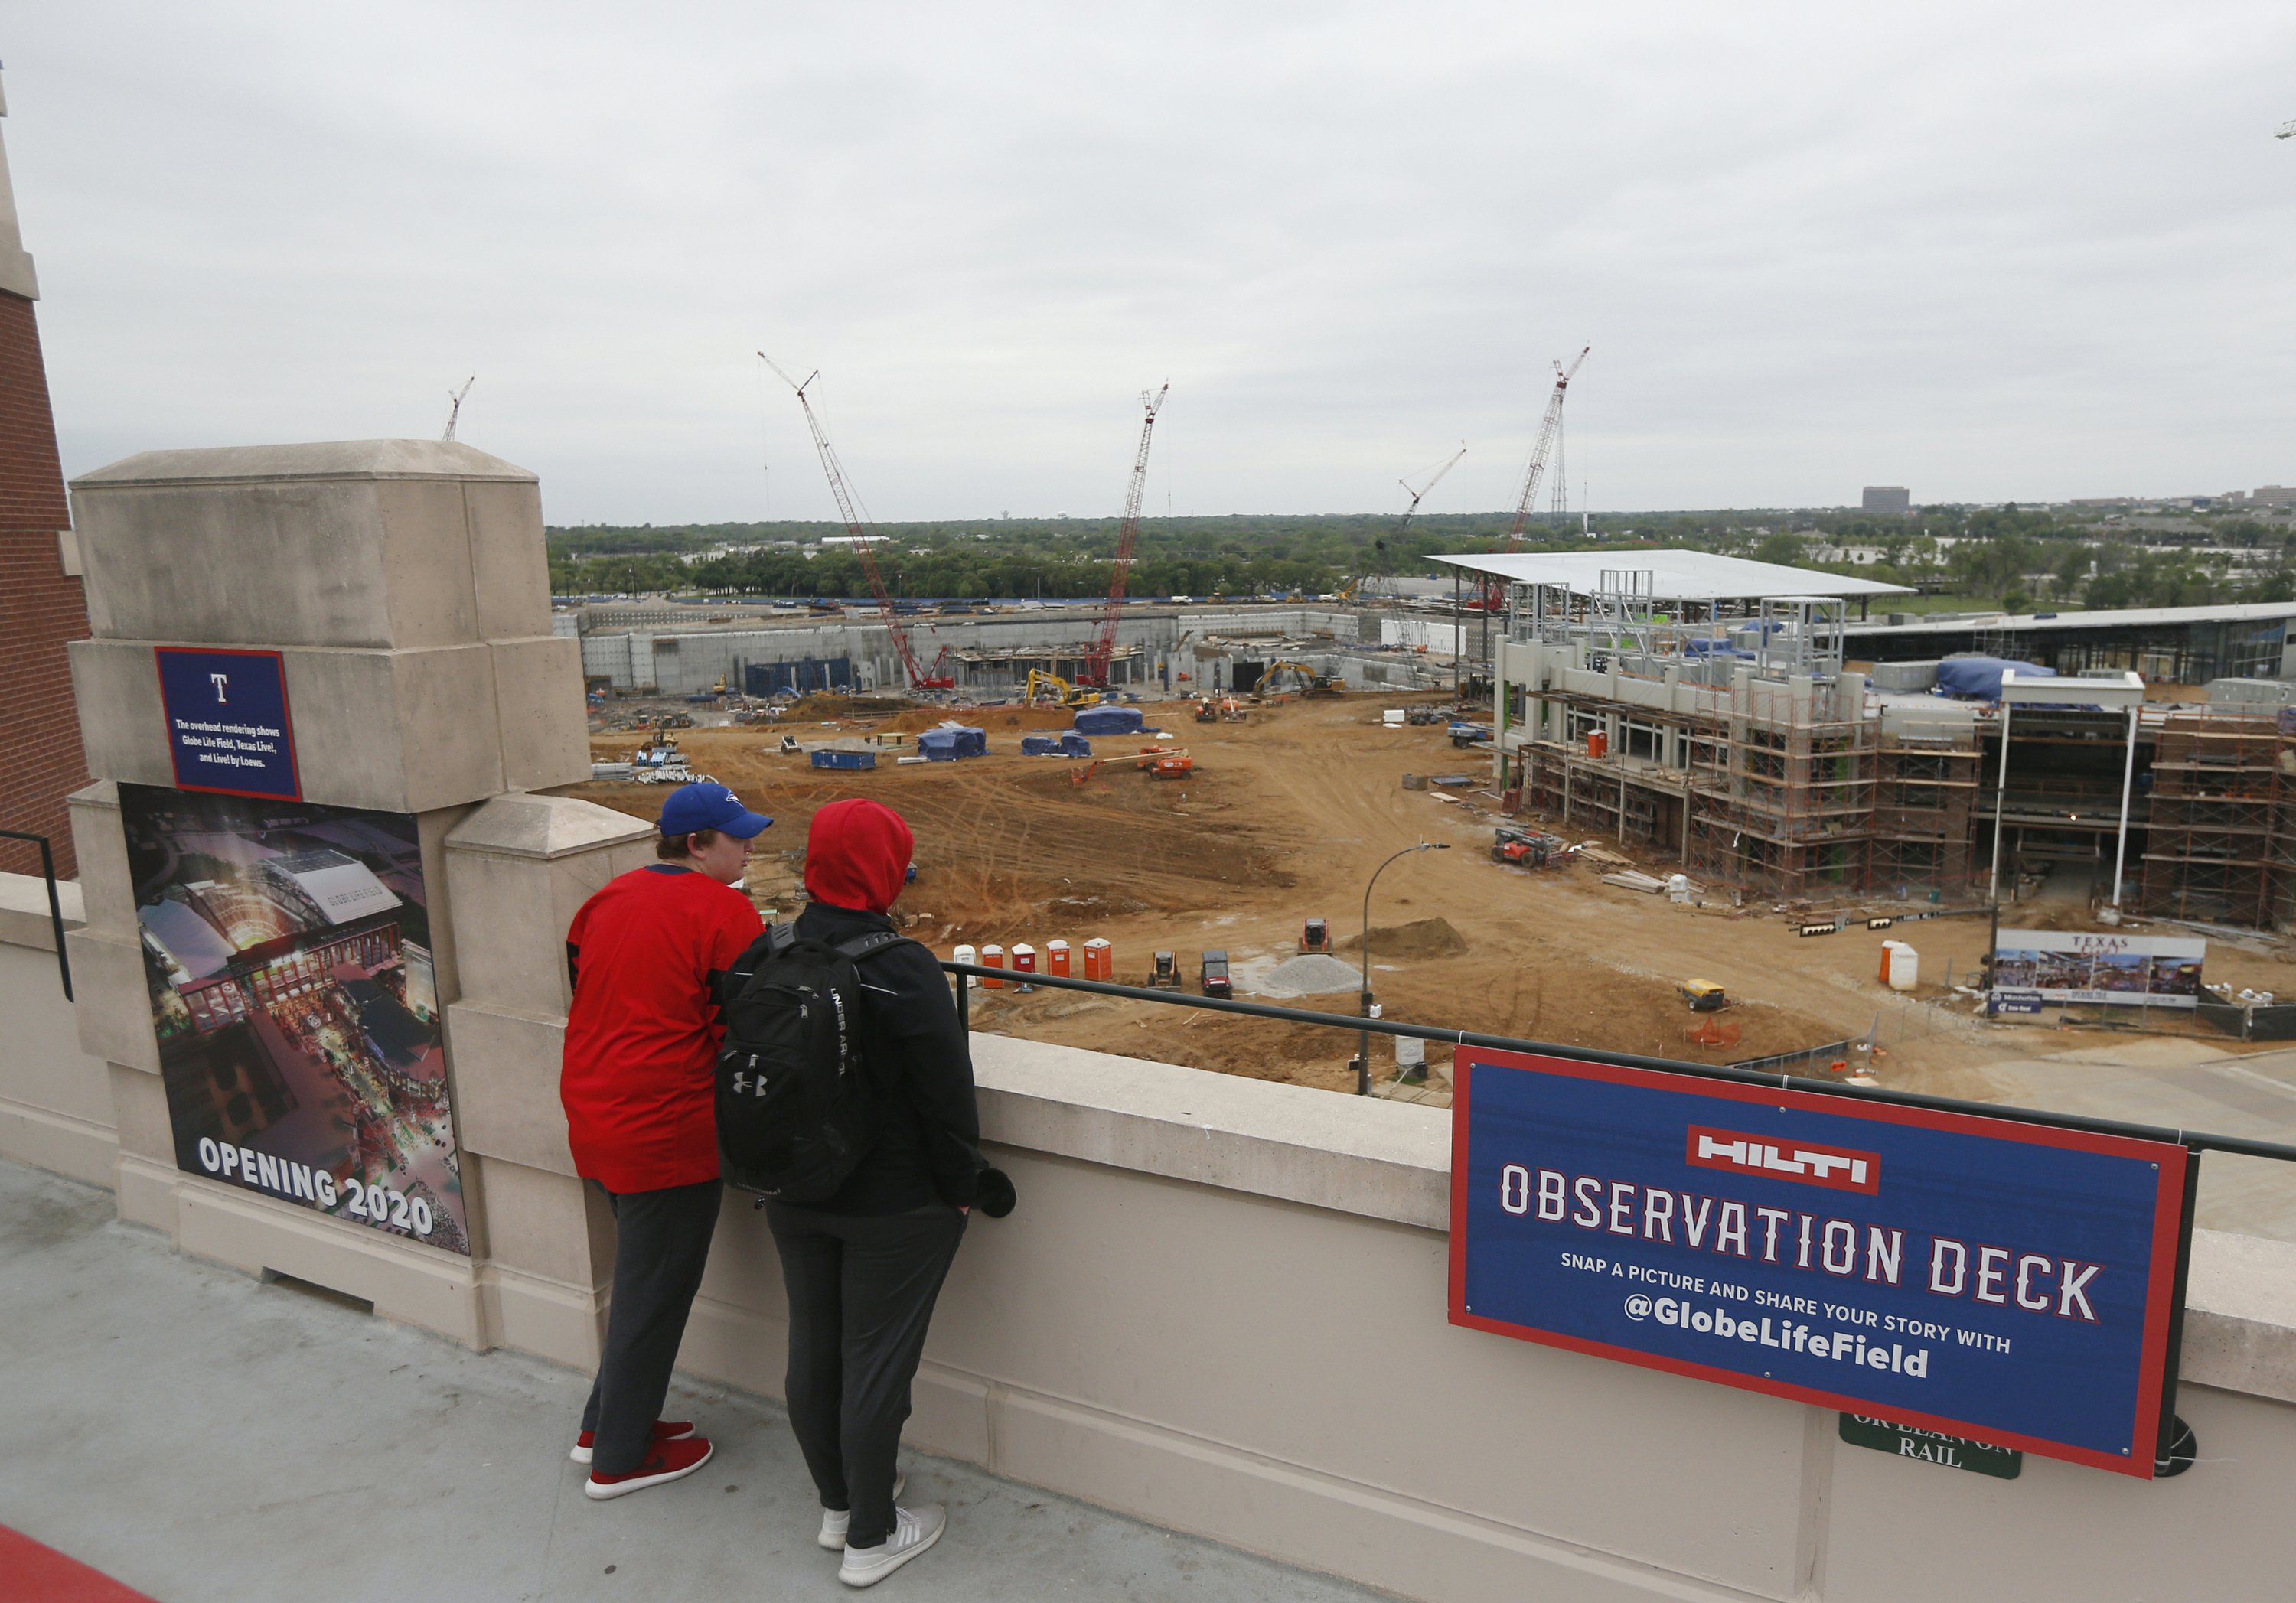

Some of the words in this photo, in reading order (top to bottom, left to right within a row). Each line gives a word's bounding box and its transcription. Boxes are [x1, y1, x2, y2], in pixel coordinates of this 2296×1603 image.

[210, 673, 228, 703] T
[175, 718, 190, 730] The
[190, 721, 222, 732] overhead
[222, 724, 256, 738] rendering
[256, 726, 280, 737] shows
[182, 735, 202, 747] Globe
[203, 736, 216, 748] Life
[217, 738, 236, 751] Field,
[236, 739, 256, 751] Texas
[199, 753, 213, 763] and
[214, 753, 230, 764] Live!
[230, 754, 240, 767] by
[240, 755, 266, 767] Loews.
[2073, 936, 2128, 948] TEXAS
[830, 987, 846, 1031] UNDER
[1698, 1135, 1867, 1184] HILTI
[199, 1137, 338, 1207] OPENING
[344, 1178, 433, 1235] 2020
[1499, 1162, 1904, 1286] OBSERVATION
[1927, 1236, 2102, 1324] DECK
[1560, 1252, 1607, 1274] SNAP
[1611, 1262, 1623, 1278] A
[1629, 1265, 1704, 1293] PICTURE
[1709, 1281, 1749, 1302] AND
[1754, 1289, 1818, 1315] SHARE
[1823, 1302, 1878, 1328] YOUR
[1883, 1315, 1951, 1341] STORY
[1956, 1328, 2011, 1354] WITH
[1624, 1293, 1929, 1379] @GlobeLifeField
[1898, 1435, 1962, 1468] RAIL
